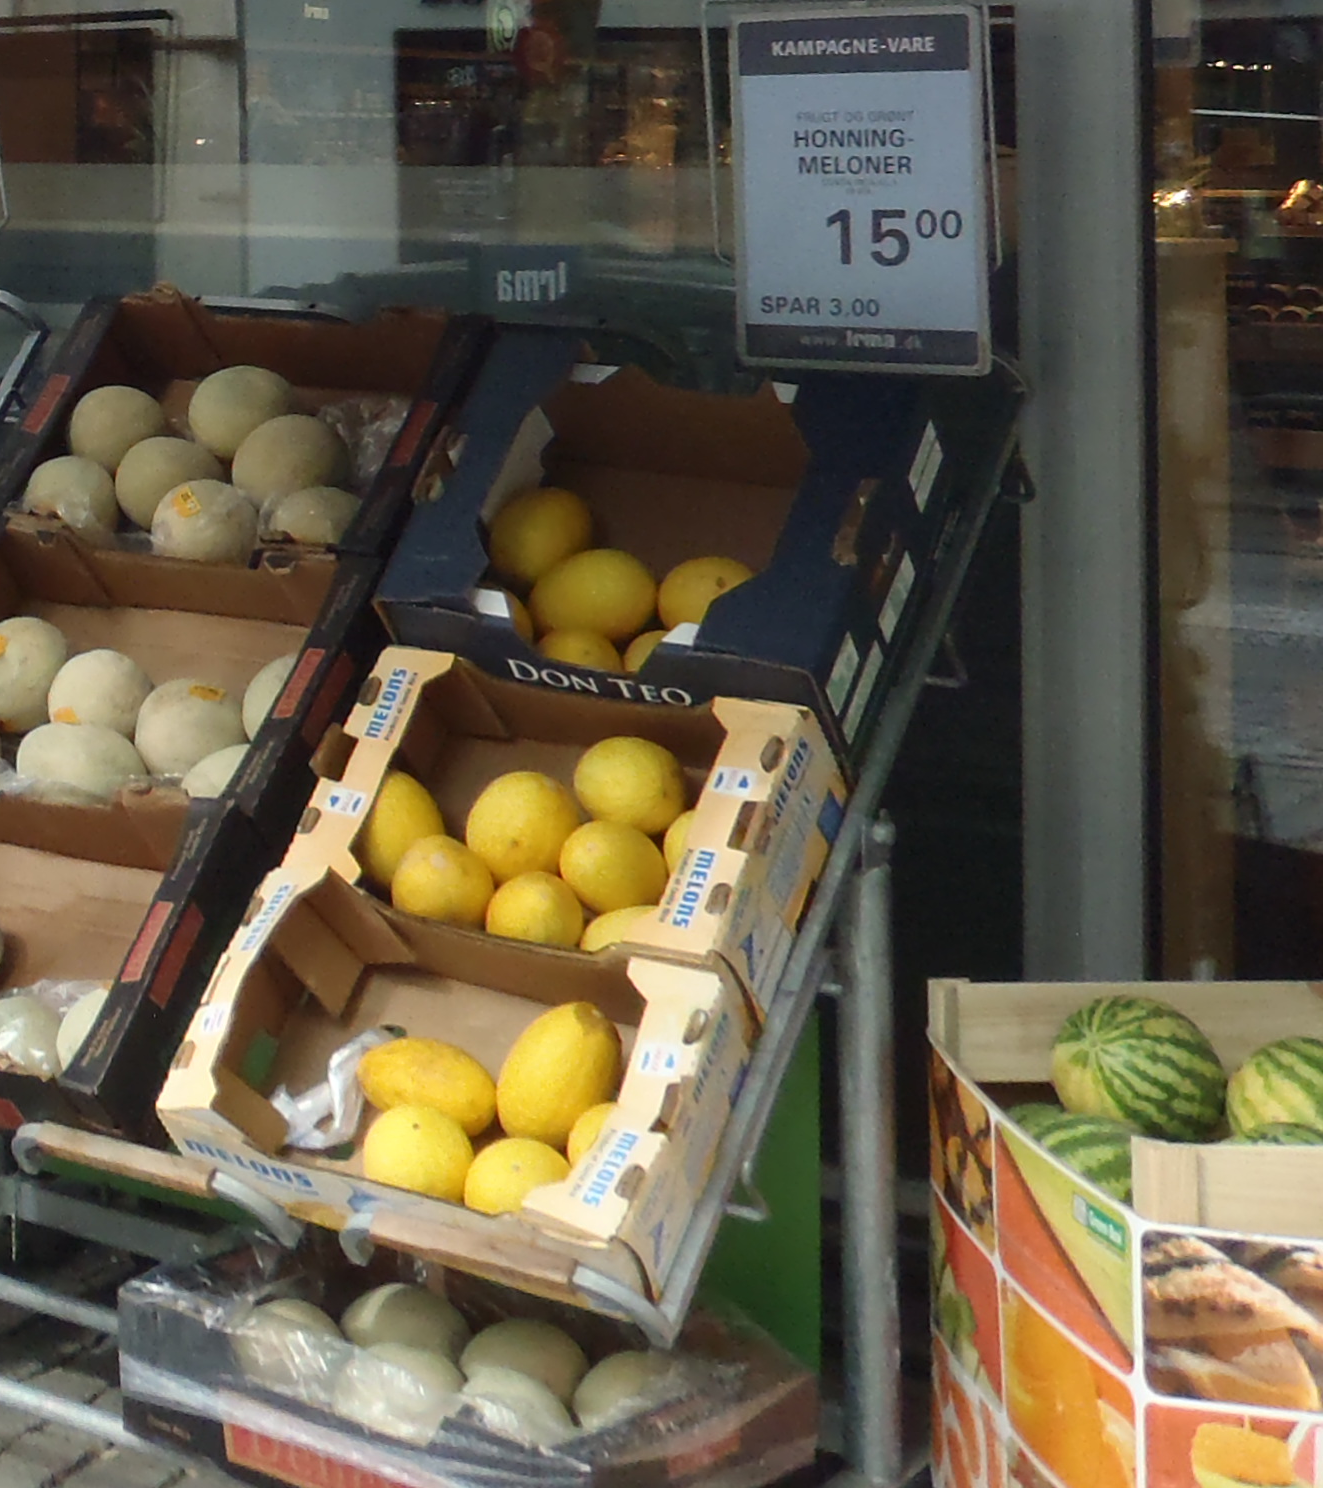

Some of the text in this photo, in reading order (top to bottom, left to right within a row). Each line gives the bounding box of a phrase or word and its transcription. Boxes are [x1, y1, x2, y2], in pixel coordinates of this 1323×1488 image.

[771, 36, 935, 57] KAMPAGNE-VARE
[793, 128, 915, 148] HONNING-
[798, 155, 912, 175] MELONER
[760, 296, 820, 315] SPAR
[507, 658, 693, 707] DON TEO
